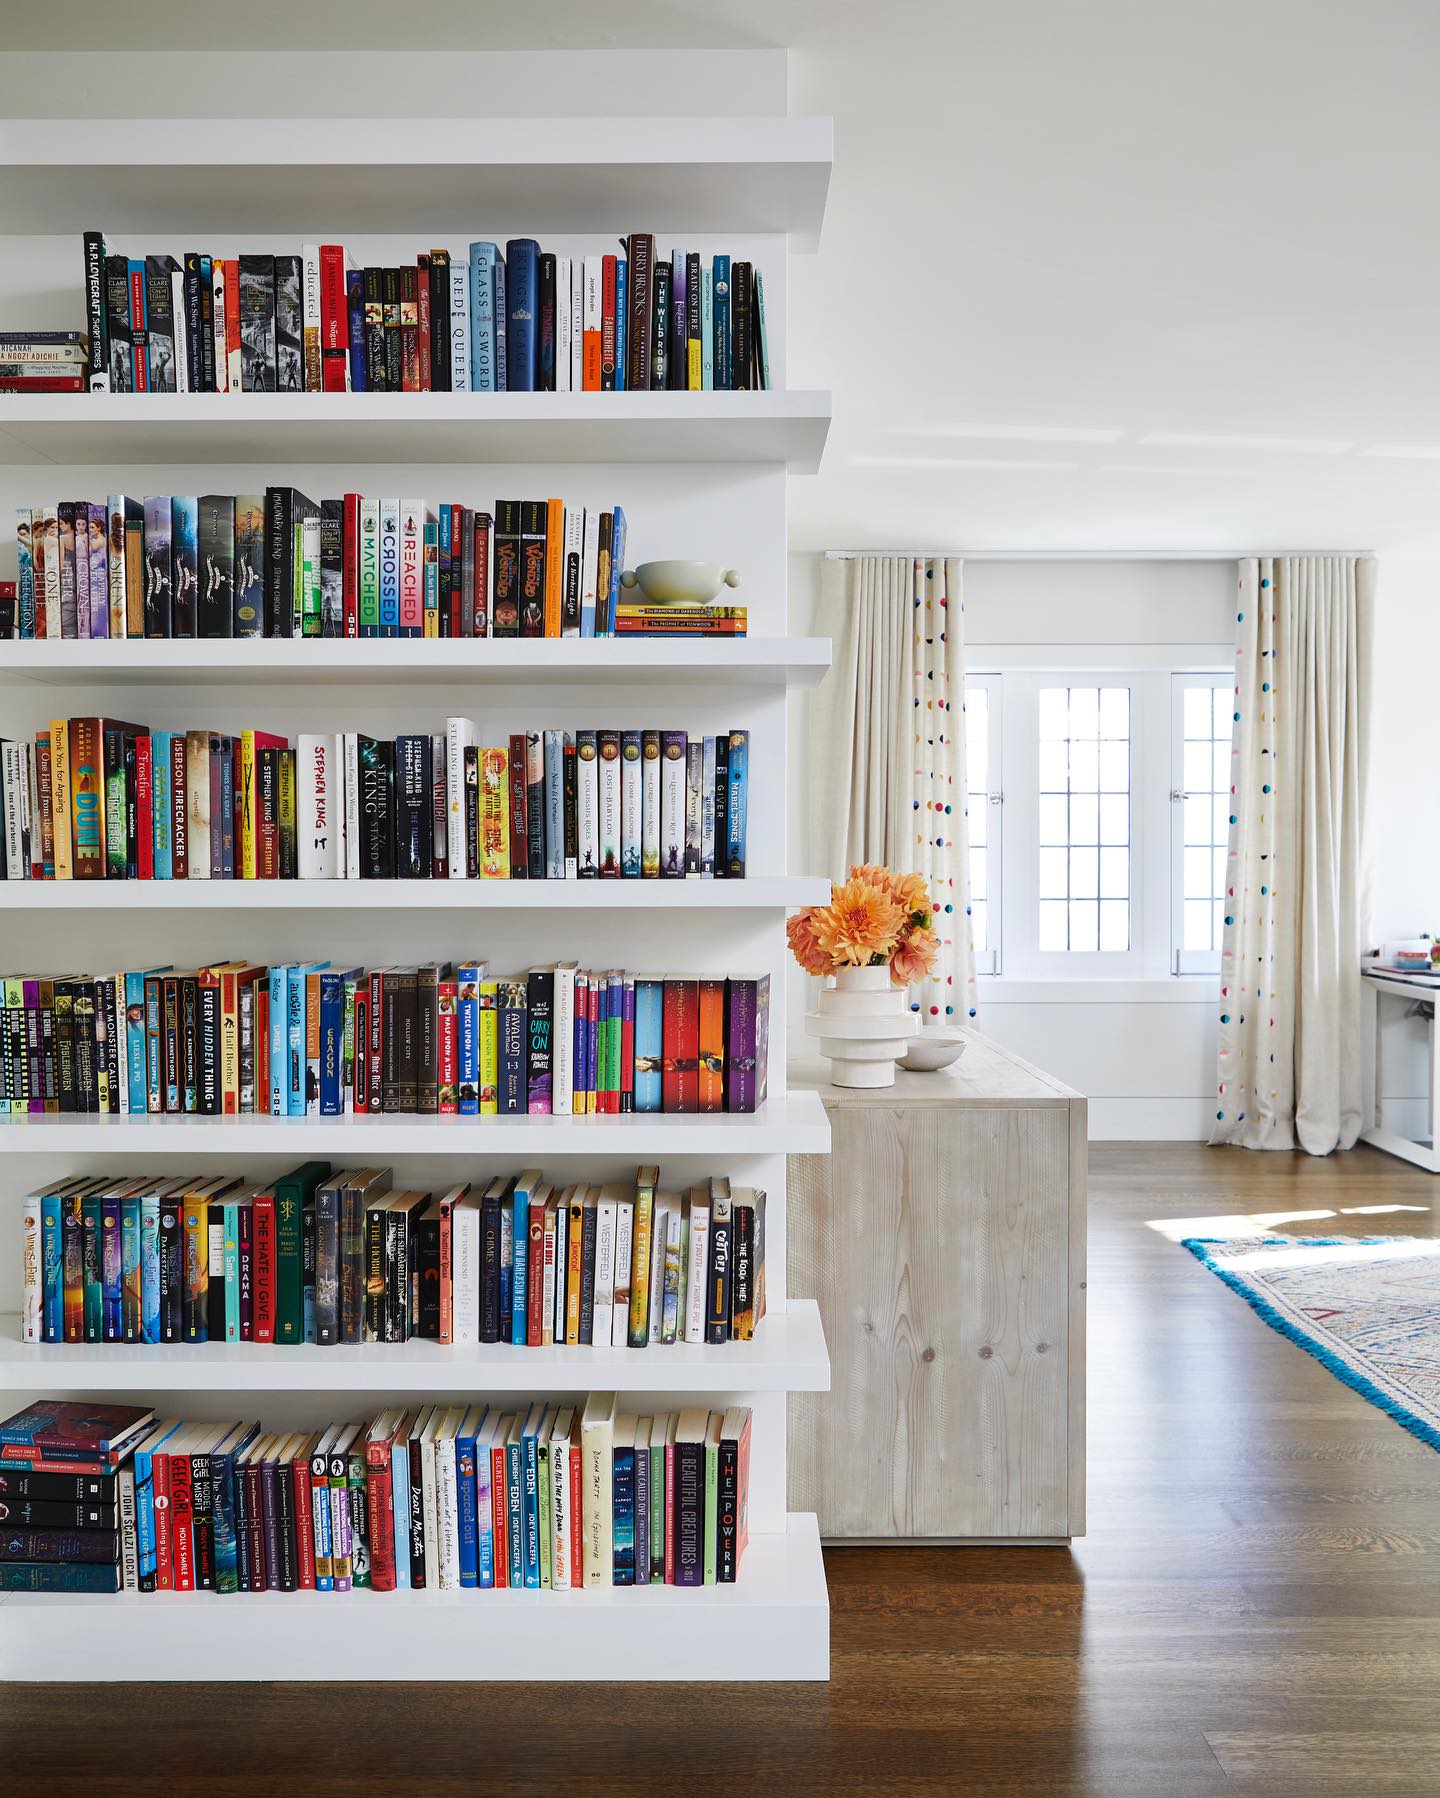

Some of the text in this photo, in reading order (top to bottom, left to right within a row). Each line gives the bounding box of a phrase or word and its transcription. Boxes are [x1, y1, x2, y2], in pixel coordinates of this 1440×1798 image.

[307, 261, 318, 318] educated
[635, 240, 646, 316] TERRY BROOKS
[691, 294, 697, 307] ON
[88, 243, 101, 368] H. P. LOVECRAFT SHORT STORIES
[190, 278, 199, 328] Why We Sleep
[214, 305, 224, 338] HOMEGOING
[478, 257, 490, 388] GLASS SWORD
[657, 308, 665, 338] WILD
[330, 320, 338, 348] Shōgun
[452, 277, 465, 389] RED QUEEN
[604, 316, 613, 361] FAHRENHEIT
[272, 493, 283, 560] IMAGINARY FRIEND
[21, 569, 32, 630] SELECTION
[34, 573, 46, 608] ELITE
[46, 571, 58, 603] ONE
[62, 567, 72, 600] HEIR
[78, 562, 89, 609] CROWN
[97, 568, 105, 605] HAPPILY
[364, 538, 374, 617] MATCHED
[384, 536, 395, 621] CROSSED
[404, 540, 415, 620] REACHED
[55, 726, 63, 751] Thank
[56, 753, 64, 768] You
[138, 751, 149, 798] Frostfire
[314, 746, 326, 829] STEPHEN KING
[364, 770, 377, 813] KING
[378, 763, 386, 819] STEPHEN
[56, 784, 65, 813] Arguing
[688, 798, 698, 833] every day
[716, 785, 724, 818] GIVER
[76, 793, 100, 859] DUNE
[175, 790, 185, 856] FIRECRACKER
[530, 799, 541, 854] SKELETON TREE
[107, 1014, 116, 1059] MONSTER
[204, 991, 214, 1100] EVERY HIDDEN THING
[307, 992, 315, 1053] PIANO MAKER
[425, 1036, 430, 1044] OF
[510, 1013, 520, 1056] AVALON
[108, 1062, 117, 1090] CALLS
[226, 1031, 234, 1085] Half Brother
[372, 1056, 381, 1090] Anne Rice
[26, 1233, 37, 1261] WINGS
[486, 1230, 494, 1263] CHIMES
[515, 1240, 524, 1276] HOW DARE
[570, 1239, 580, 1274] Innocent
[600, 1224, 610, 1280] WESTERFELD
[619, 1222, 629, 1280] WESTERFELD
[637, 1193, 647, 1282] EMILY ETERNAL
[27, 1267, 37, 1286] FIRE
[160, 1236, 168, 1295] DARKSTALKER
[225, 1256, 236, 1282] Smile
[258, 1213, 269, 1320] THE HATE U GIVE
[581, 1212, 594, 1330] ARTEMIS ANDY WEIR
[485, 1306, 493, 1327] TIMES
[514, 1280, 524, 1311] SUN RISE
[172, 1457, 188, 1517] GEEK GIRL
[495, 1456, 503, 1484] SECRET
[194, 1482, 202, 1511] MISFIT
[462, 1480, 474, 1544] spaced out
[681, 1458, 697, 1564] BEAUTIFUL CREATURES
[123, 1494, 135, 1588] JOHN SCALZI LOCK IN
[159, 1512, 167, 1566] counting by 7s
[412, 1486, 424, 1556] Dear Martin
